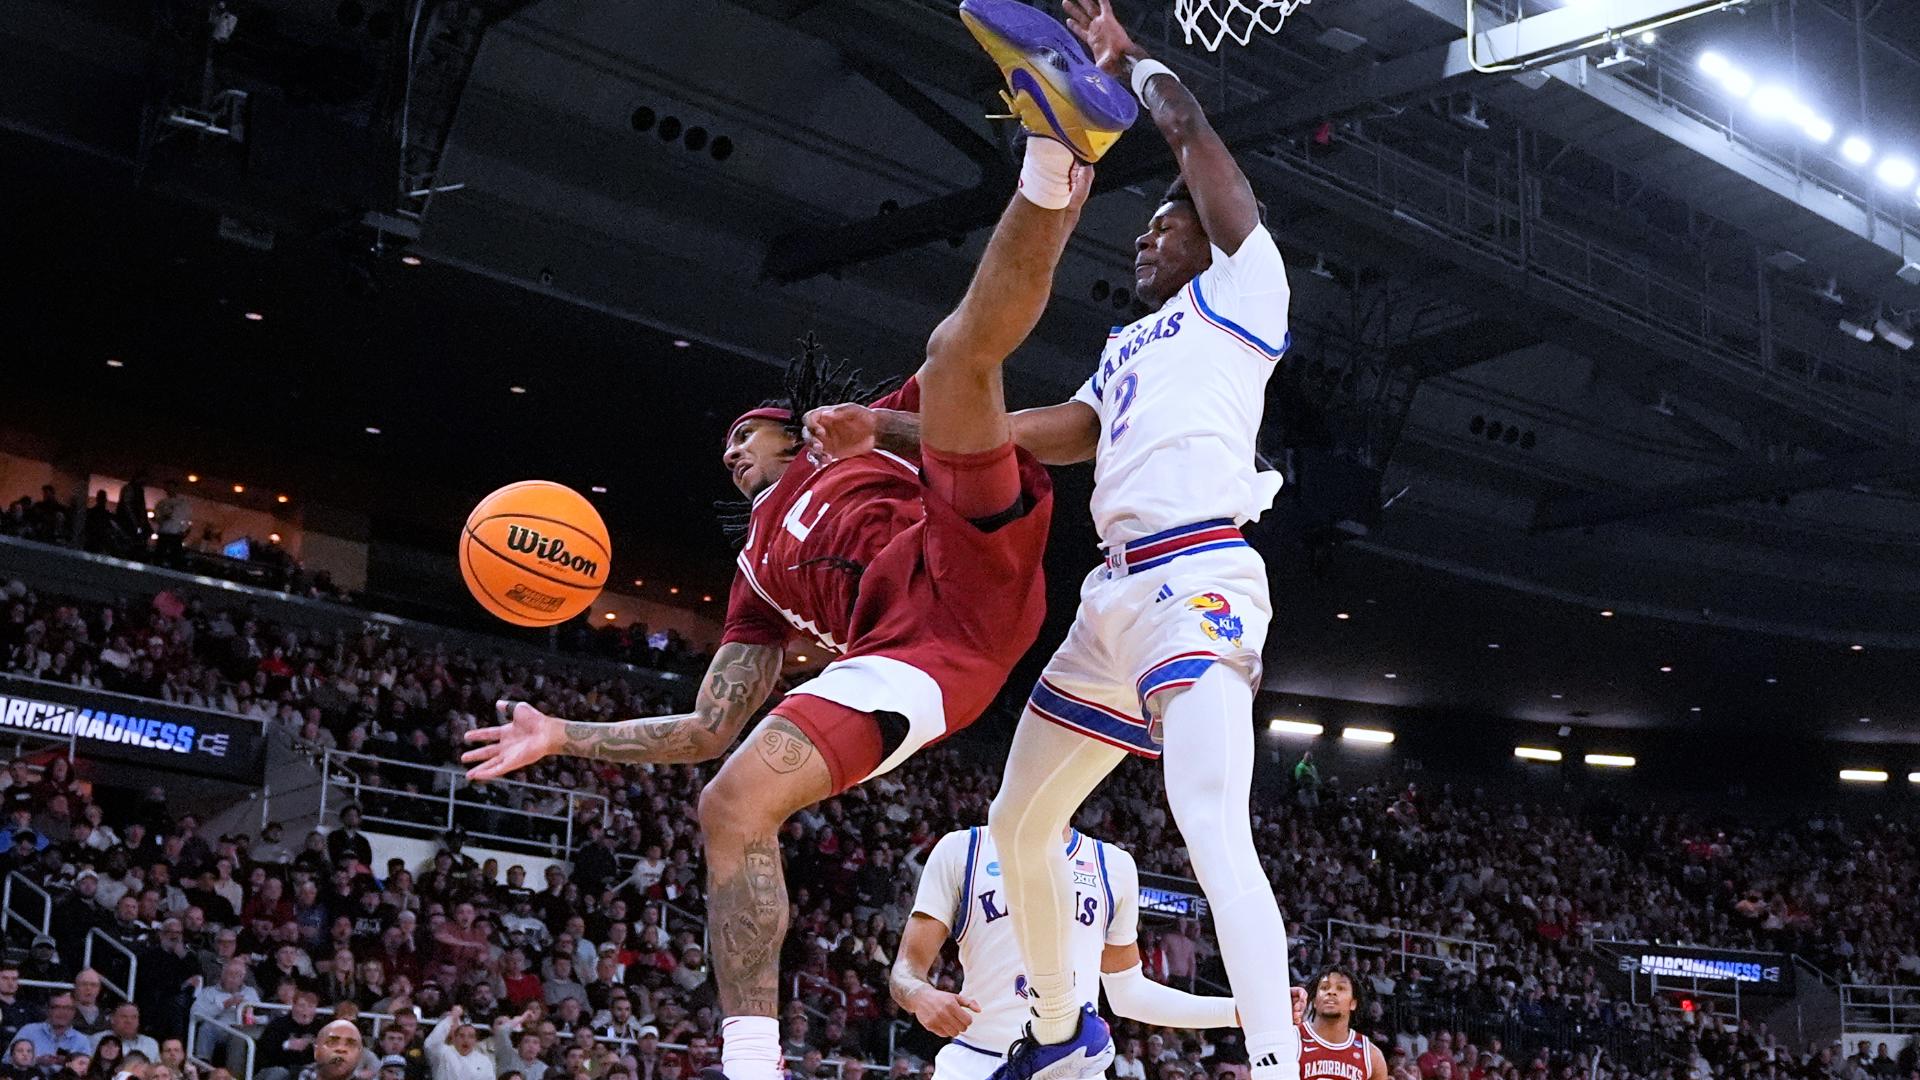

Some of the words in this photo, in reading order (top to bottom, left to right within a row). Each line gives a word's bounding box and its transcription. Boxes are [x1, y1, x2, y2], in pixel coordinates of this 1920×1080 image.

[1097, 311, 1185, 402] ANSAS
[1111, 372, 1139, 446] 2
[507, 524, 598, 579] Wilson
[1218, 617, 1235, 631] KU
[763, 730, 803, 766] 95
[1640, 955, 1761, 982] MARCHMADNESS
[1304, 1059, 1363, 1080] RAZORBACKS
